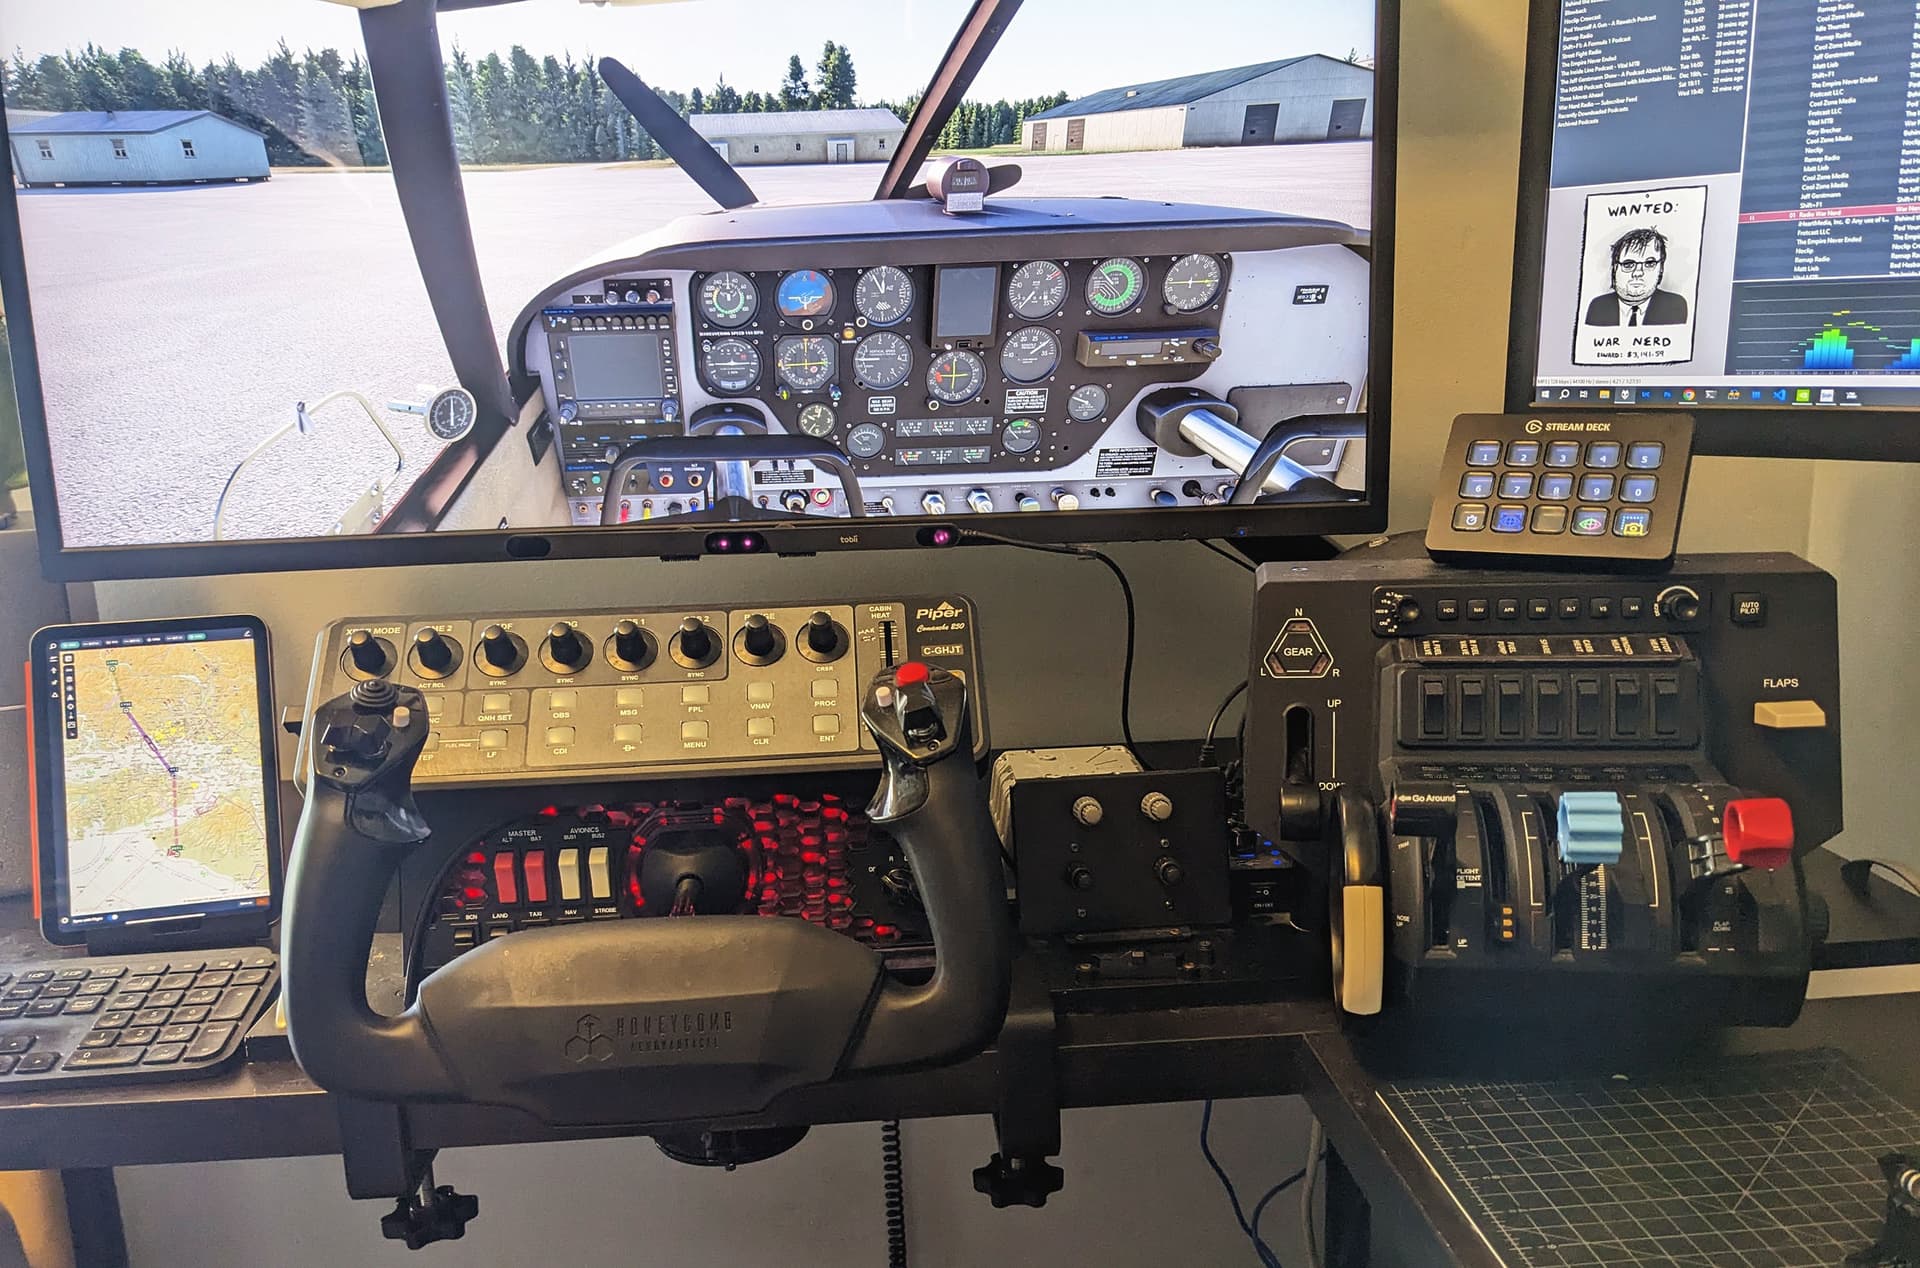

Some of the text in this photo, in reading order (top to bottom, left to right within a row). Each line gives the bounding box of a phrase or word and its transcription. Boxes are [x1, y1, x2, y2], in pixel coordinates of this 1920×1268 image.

[1608, 202, 1679, 217] WANTED:
[1594, 337, 1672, 347] WAR NERD
[1545, 423, 1611, 432] STREAM DECK
[1521, 454, 1527, 462] 2
[1475, 485, 1482, 493] 6
[1553, 487, 1560, 495] 8
[1635, 489, 1642, 497] 0
[840, 535, 858, 544] tobii
[916, 608, 963, 621] Piper
[1295, 608, 1303, 617] N
[373, 627, 401, 635] MODE
[951, 622, 965, 631] 250
[924, 645, 962, 655] C-GHJT
[1284, 648, 1313, 657] GEAR
[1261, 668, 1267, 677] L
[1333, 668, 1340, 677] R
[1763, 679, 1799, 688] FLAPS
[1327, 699, 1342, 708] UP
[684, 741, 707, 749] MENU
[1319, 782, 1346, 791] DOW
[616, 1012, 731, 1037] HONEYCOMB
